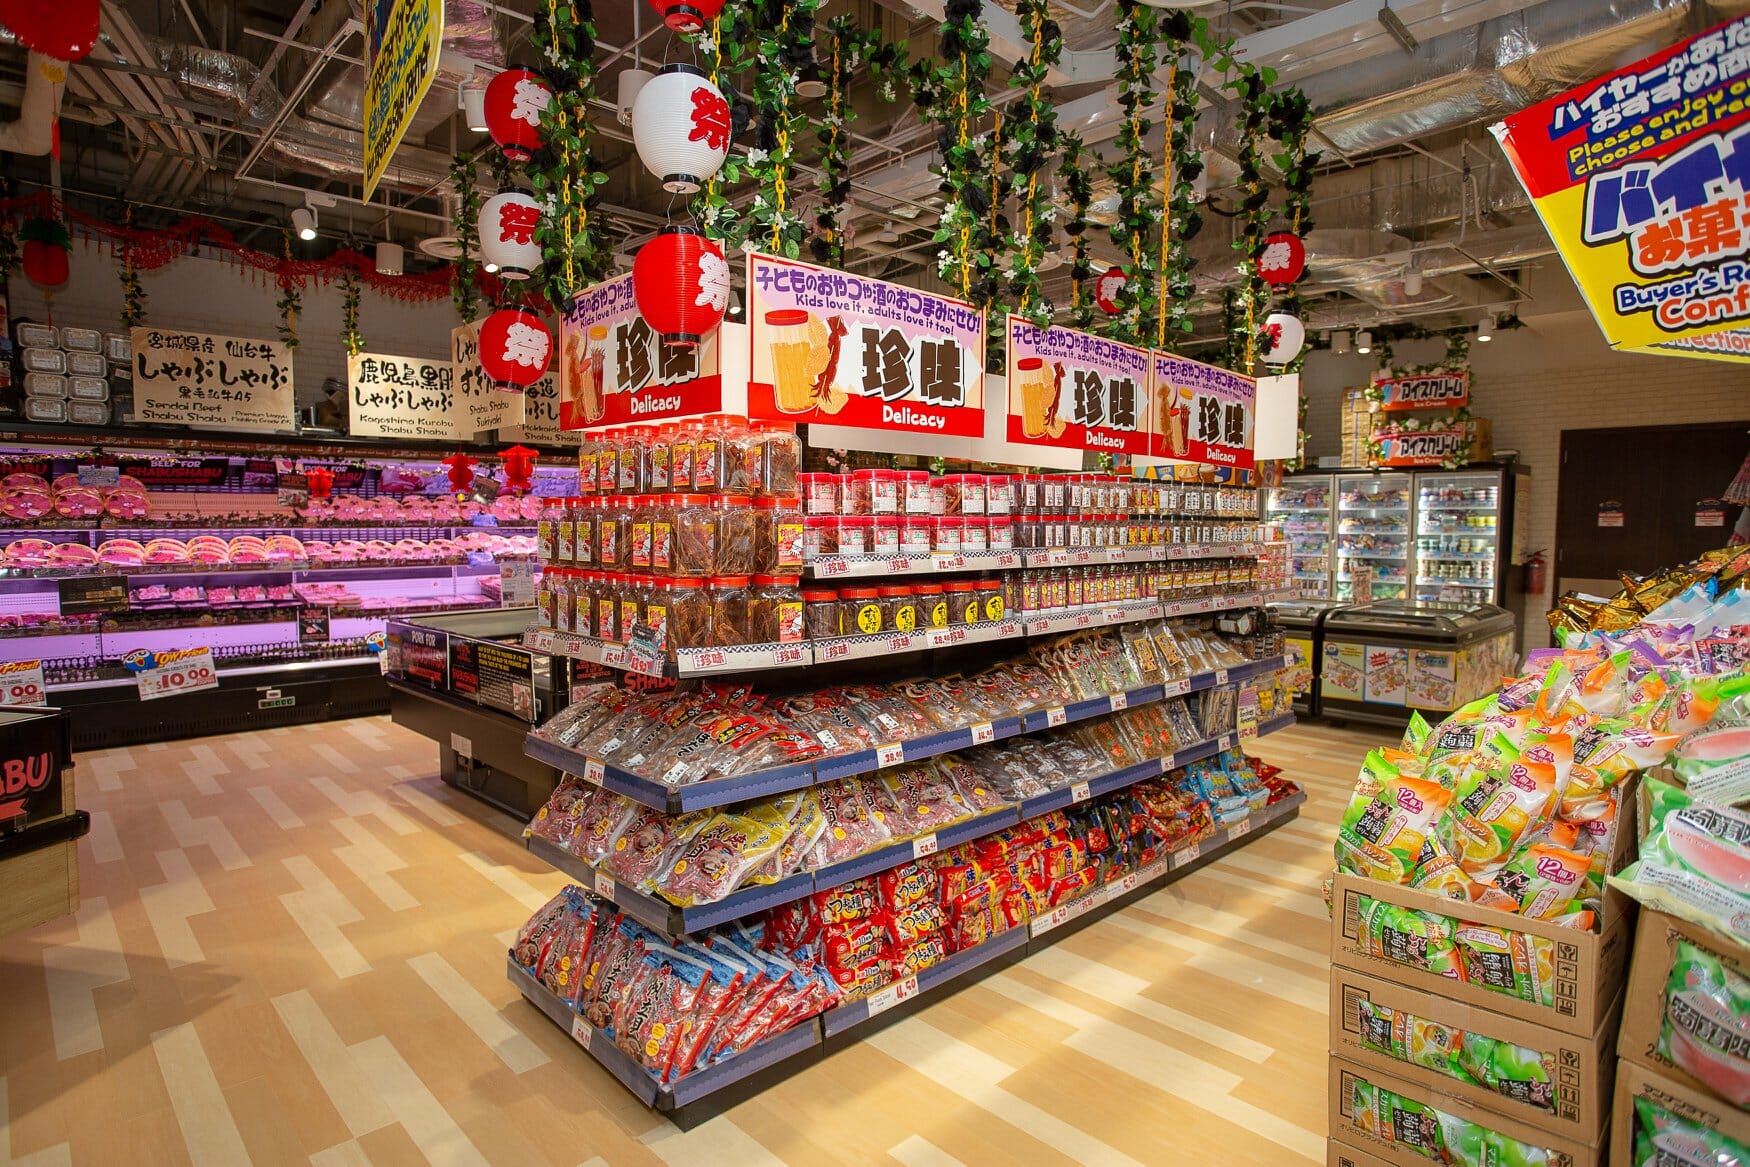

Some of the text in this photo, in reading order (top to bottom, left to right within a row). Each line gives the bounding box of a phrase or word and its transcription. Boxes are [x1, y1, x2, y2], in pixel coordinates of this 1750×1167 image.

[1569, 79, 1750, 163] Please enjoy o
[1574, 96, 1750, 175] choose and re
[1638, 192, 1750, 266] お菓
[1621, 265, 1750, 308] Buyer's R
[580, 314, 595, 329] Kids
[596, 309, 609, 321] love
[796, 294, 824, 307] Kids
[826, 297, 850, 311] love
[868, 305, 902, 320] adults
[903, 311, 924, 327] love
[926, 318, 933, 329] it
[935, 321, 954, 335] too!
[225, 340, 276, 361] 仙台牛
[1035, 346, 1052, 356] Kids
[1052, 347, 1068, 358] love
[1078, 353, 1098, 363] adults
[1099, 358, 1112, 368] love
[138, 352, 288, 390] しゃぶしゃぶ
[862, 327, 962, 400] 珍味
[354, 387, 453, 412] しゃぶしゃぶ
[1074, 370, 1136, 428] 珍味
[1401, 378, 1463, 401] アイスクリーム
[469, 400, 509, 415] Shabu Shabu
[630, 396, 681, 415] Delicacy
[142, 410, 183, 420] Shabu
[187, 412, 227, 423] Shabu
[360, 414, 416, 426] Kagoshima
[476, 414, 502, 427] Sukiyaki
[882, 405, 946, 428] Delicacy
[1198, 396, 1245, 446] 珍味
[379, 425, 448, 436] Shabu Shabu
[525, 433, 552, 441] Shabu
[1085, 431, 1125, 450] Delicacy
[1206, 448, 1236, 464] Delicacy
[1400, 436, 1459, 456] アイスクリーム
[425, 634, 436, 647] FOR
